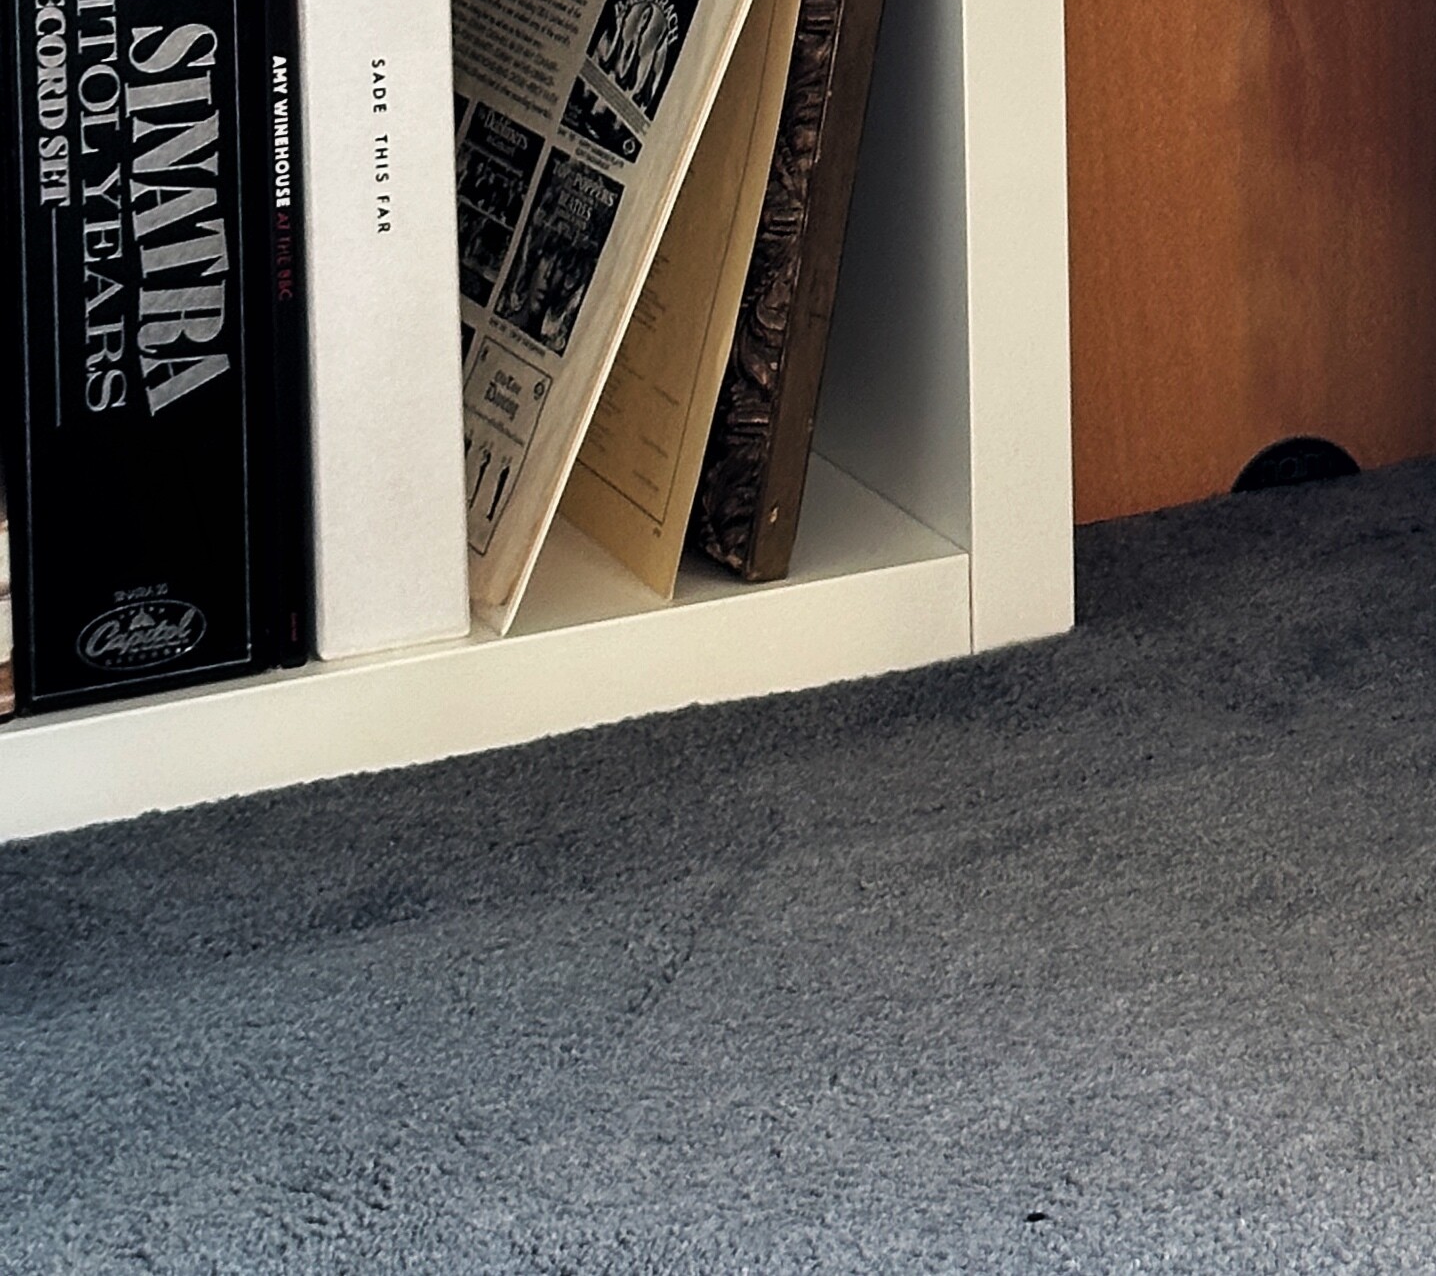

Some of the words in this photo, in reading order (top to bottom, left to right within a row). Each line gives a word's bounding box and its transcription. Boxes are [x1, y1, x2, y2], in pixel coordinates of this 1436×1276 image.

[272, 54, 287, 97] AMY
[371, 58, 387, 114] SADE
[39, 134, 71, 207] SET
[273, 99, 291, 208] WINEHOUSE
[375, 134, 390, 184] THIS
[126, 24, 230, 416] SINATRA
[276, 211, 288, 228] AT
[377, 194, 391, 235] FAR
[82, 162, 127, 412] YEARS
[84, 607, 197, 656] Capitol
